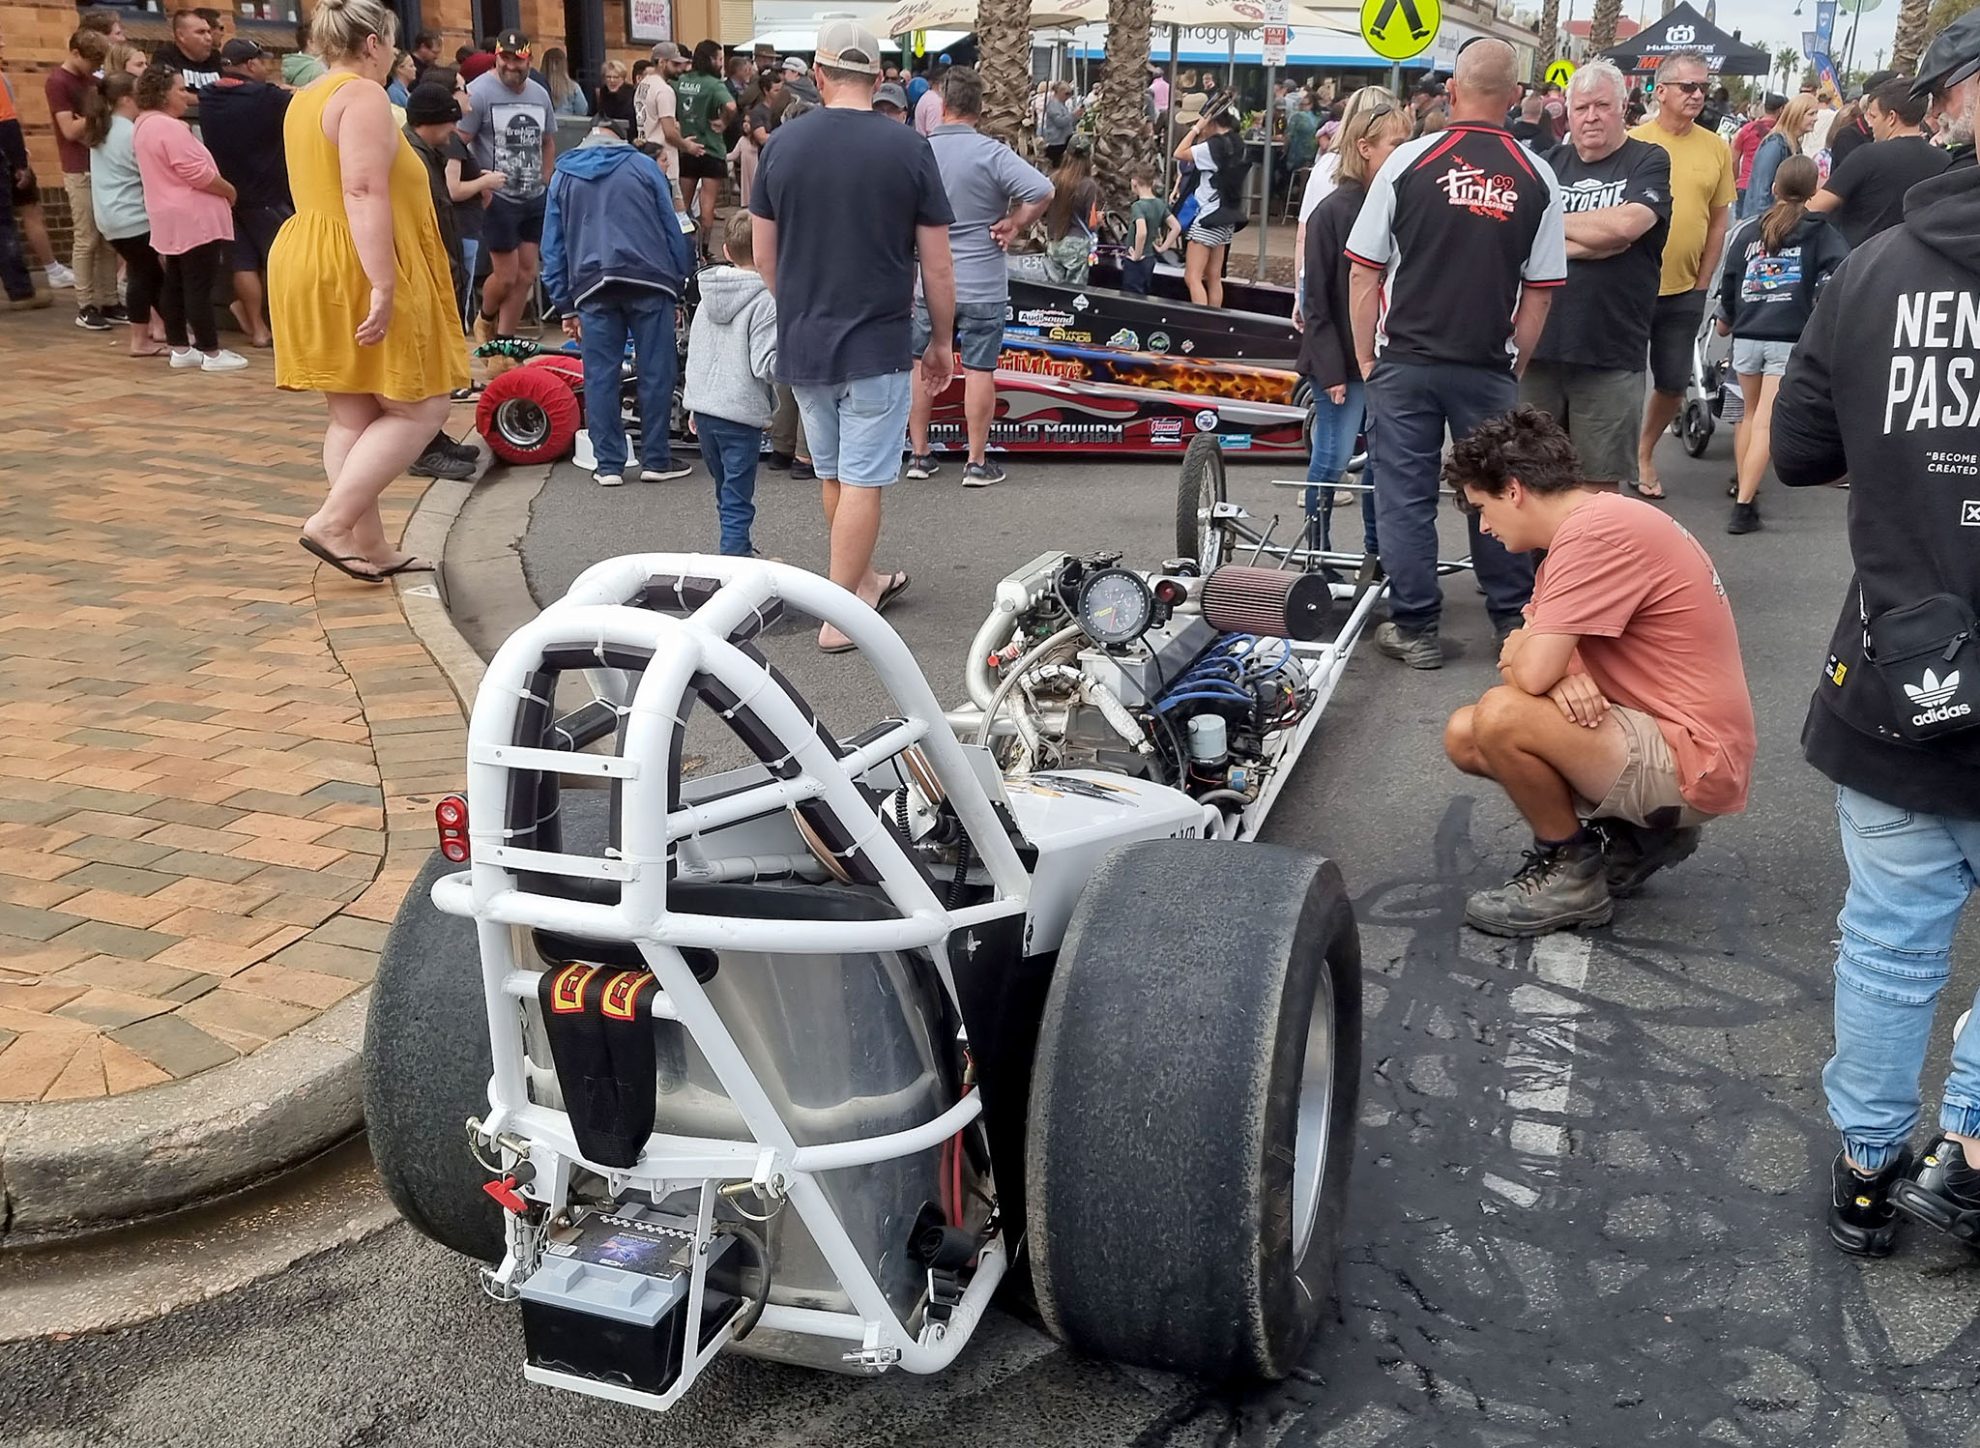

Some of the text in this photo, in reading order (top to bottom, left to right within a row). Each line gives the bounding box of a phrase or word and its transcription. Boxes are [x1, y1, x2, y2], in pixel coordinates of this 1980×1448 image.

[1436, 166, 1518, 206] Finke
[1492, 174, 1514, 190] 09
[1560, 184, 1627, 212] RYDENE
[1927, 463, 1978, 475] CREATED
[1912, 703, 1971, 726] adidas
